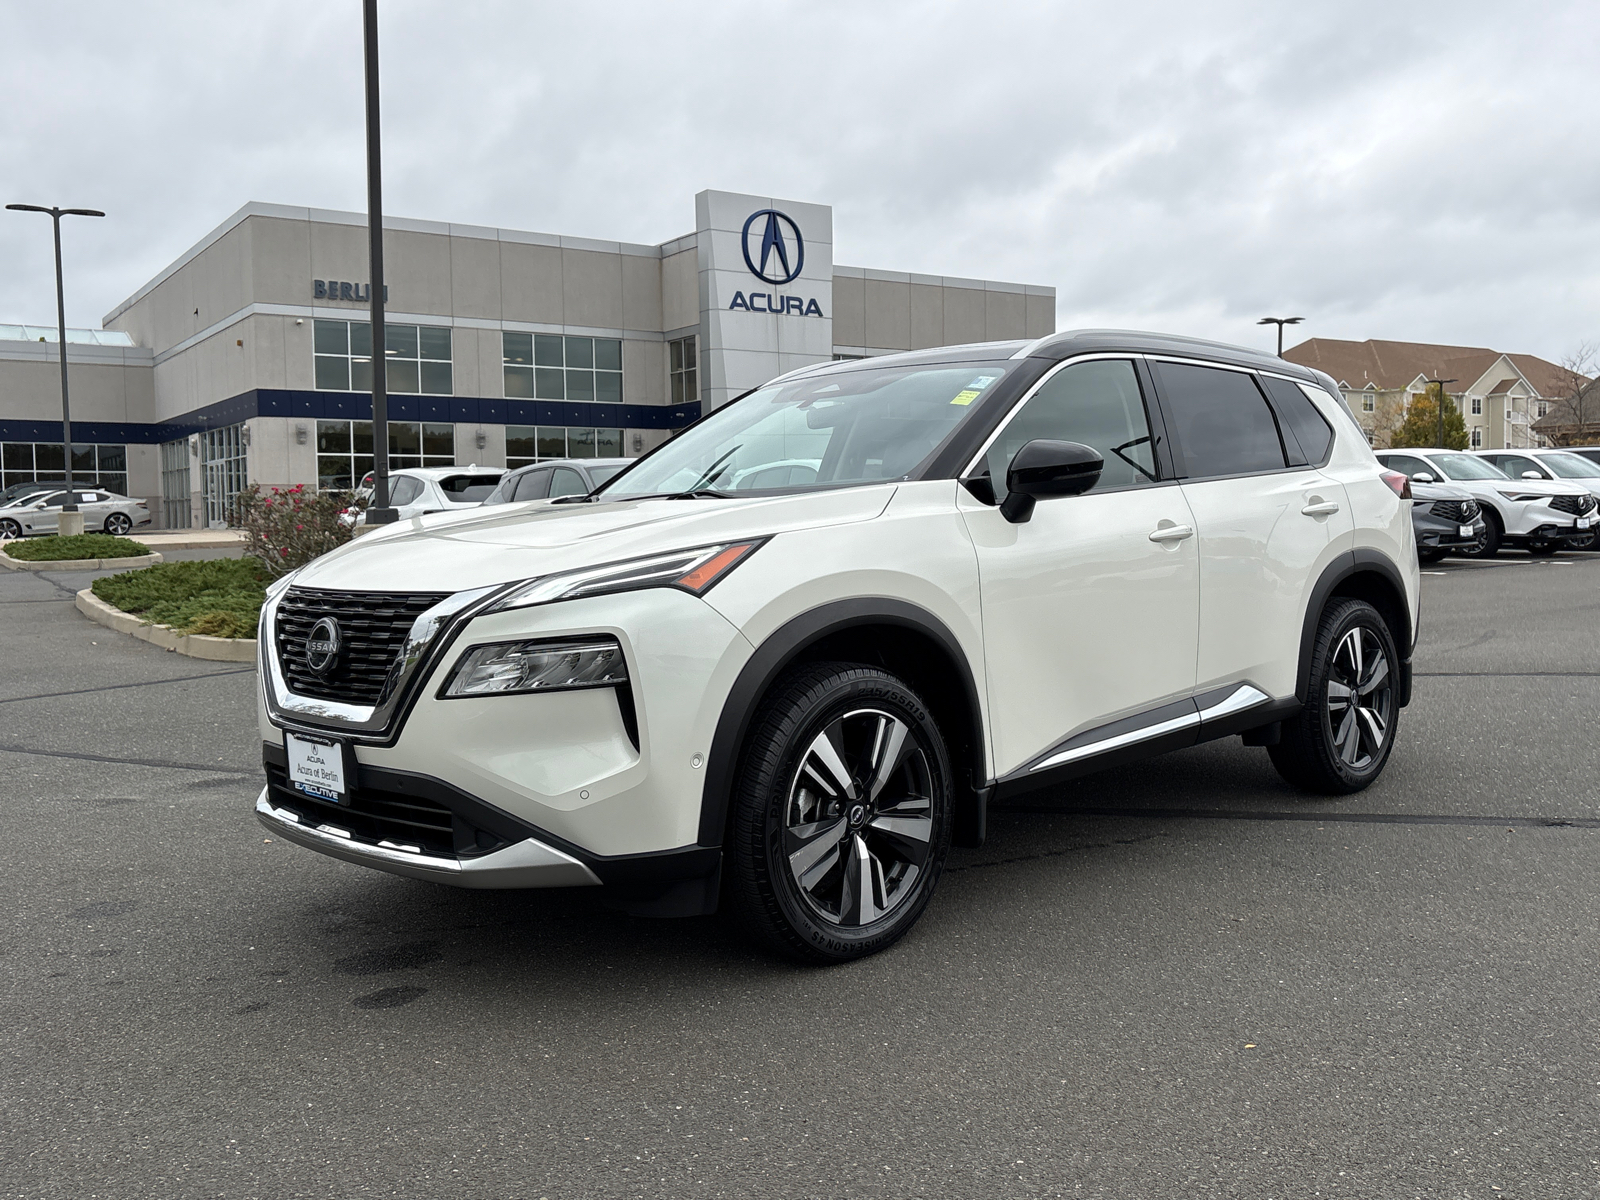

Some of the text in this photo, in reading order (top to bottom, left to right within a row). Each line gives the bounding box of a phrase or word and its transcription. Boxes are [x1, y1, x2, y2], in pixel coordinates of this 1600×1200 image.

[729, 290, 824, 317] ACURA
[306, 640, 337, 652] NISSAN
[306, 755, 326, 766] ACURA
[297, 763, 339, 782] Acura of Berlin
[294, 782, 339, 800] EXECUTIVE
